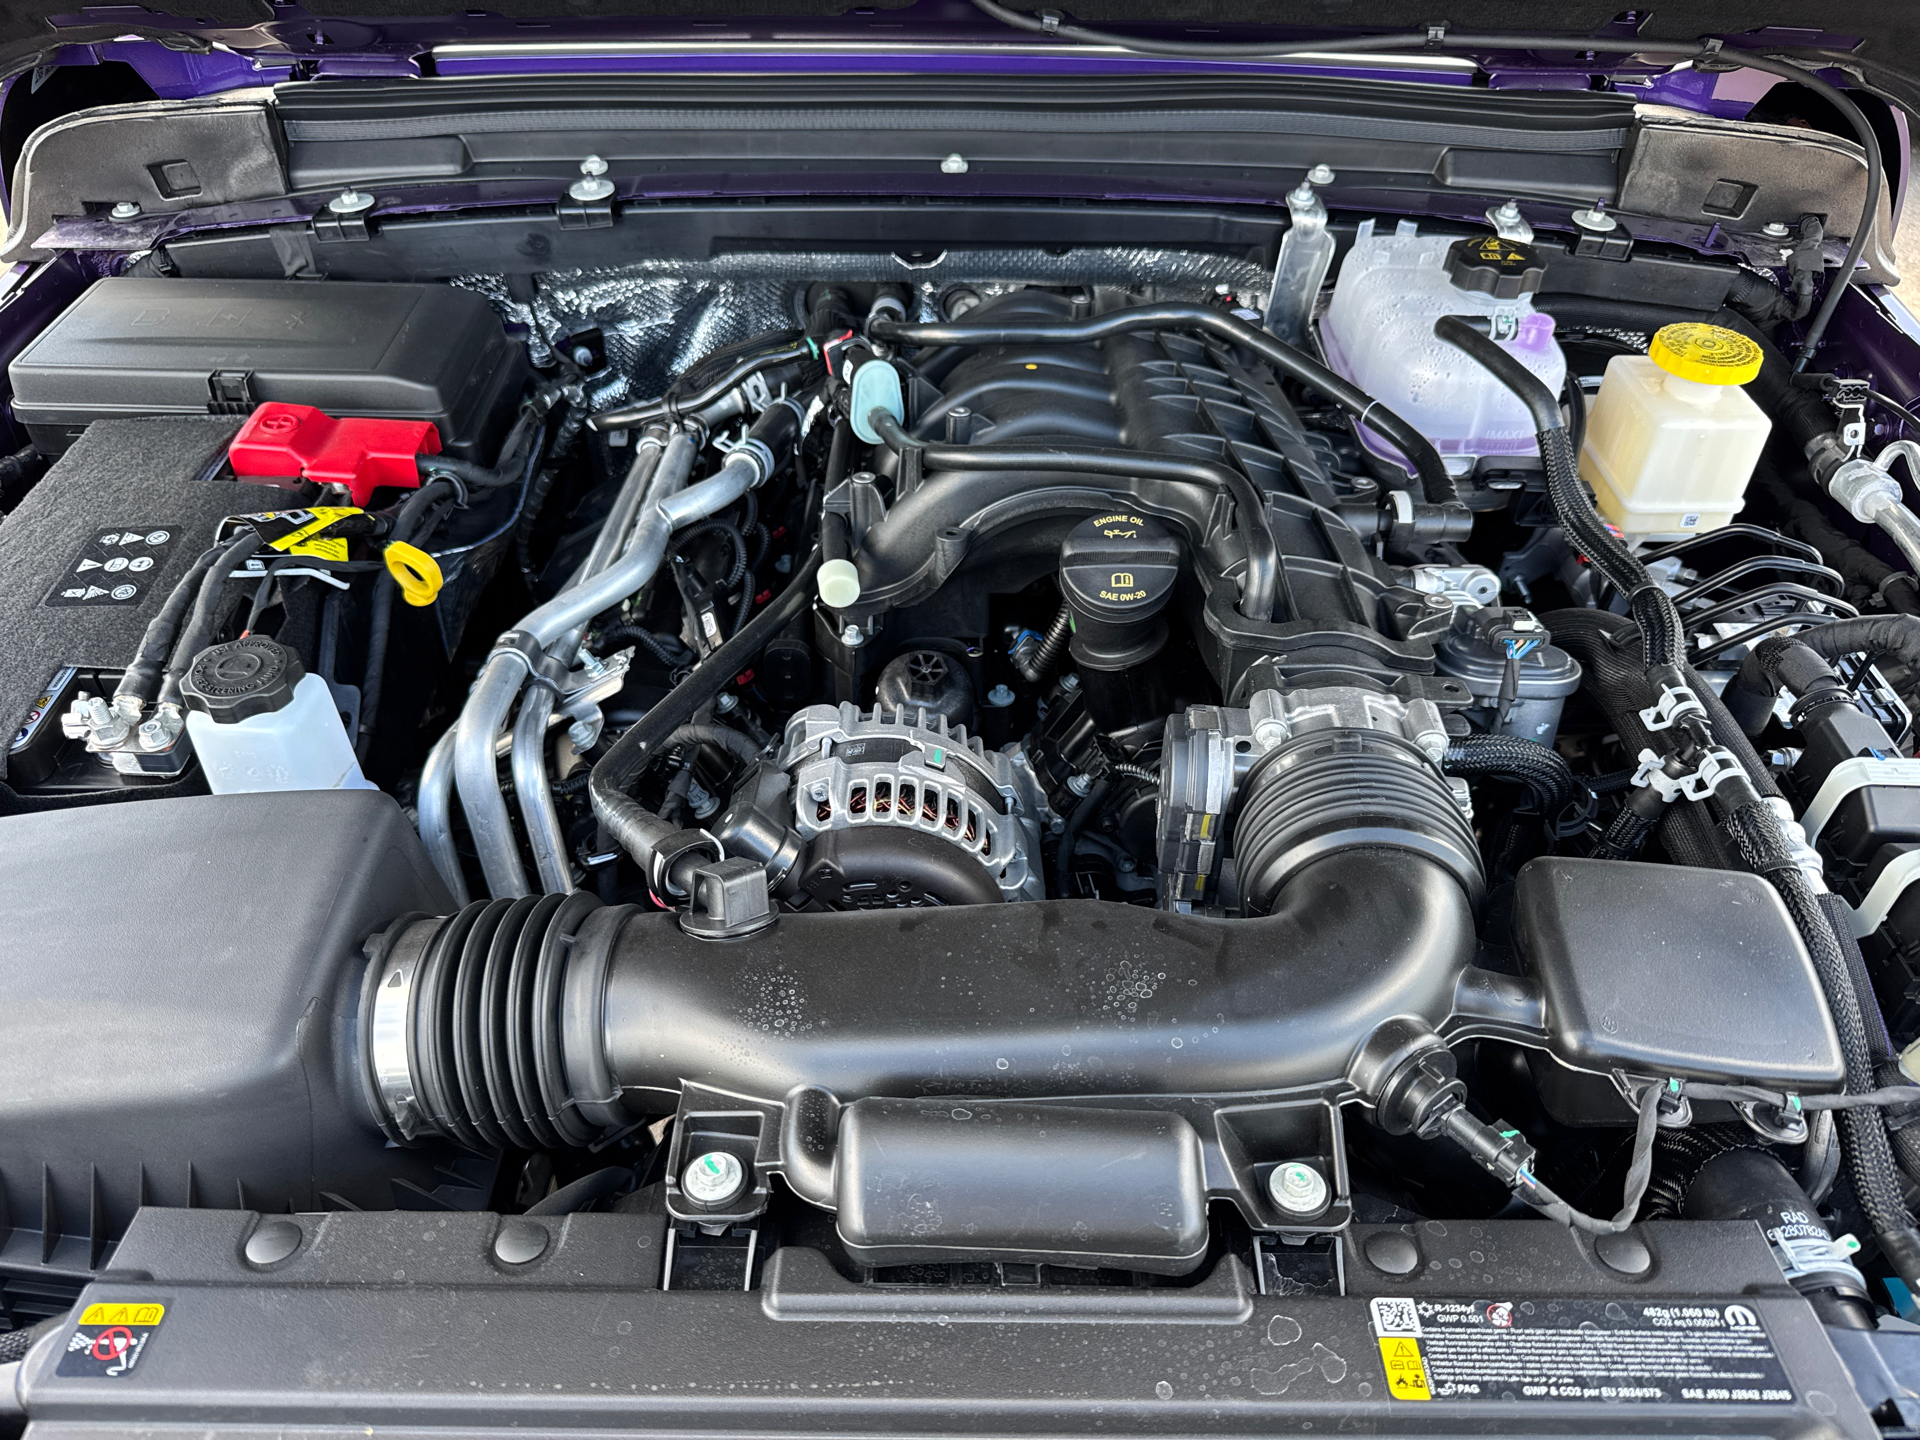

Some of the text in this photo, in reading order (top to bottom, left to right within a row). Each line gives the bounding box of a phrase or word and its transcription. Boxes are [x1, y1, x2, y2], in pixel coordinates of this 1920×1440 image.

[1093, 515, 1144, 527] ENGINE OIL
[1099, 590, 1147, 601] SAE 0W-20
[235, 640, 280, 657] APPROVED
[206, 682, 255, 694] STEERING
[1780, 1211, 1809, 1224] RAD
[1766, 1224, 1831, 1242] 6280782AD
[1436, 1315, 1484, 1323] GWP 0.501
[1652, 1318, 1673, 1327] CO2
[1457, 1384, 1480, 1394] PAG
[1523, 1385, 1548, 1396] GWP
[1549, 1386, 1558, 1396] &
[1560, 1386, 1582, 1397] CO2
[1583, 1388, 1600, 1398] per
[1601, 1387, 1617, 1397] EU
[1681, 1388, 1705, 1399] SAE
